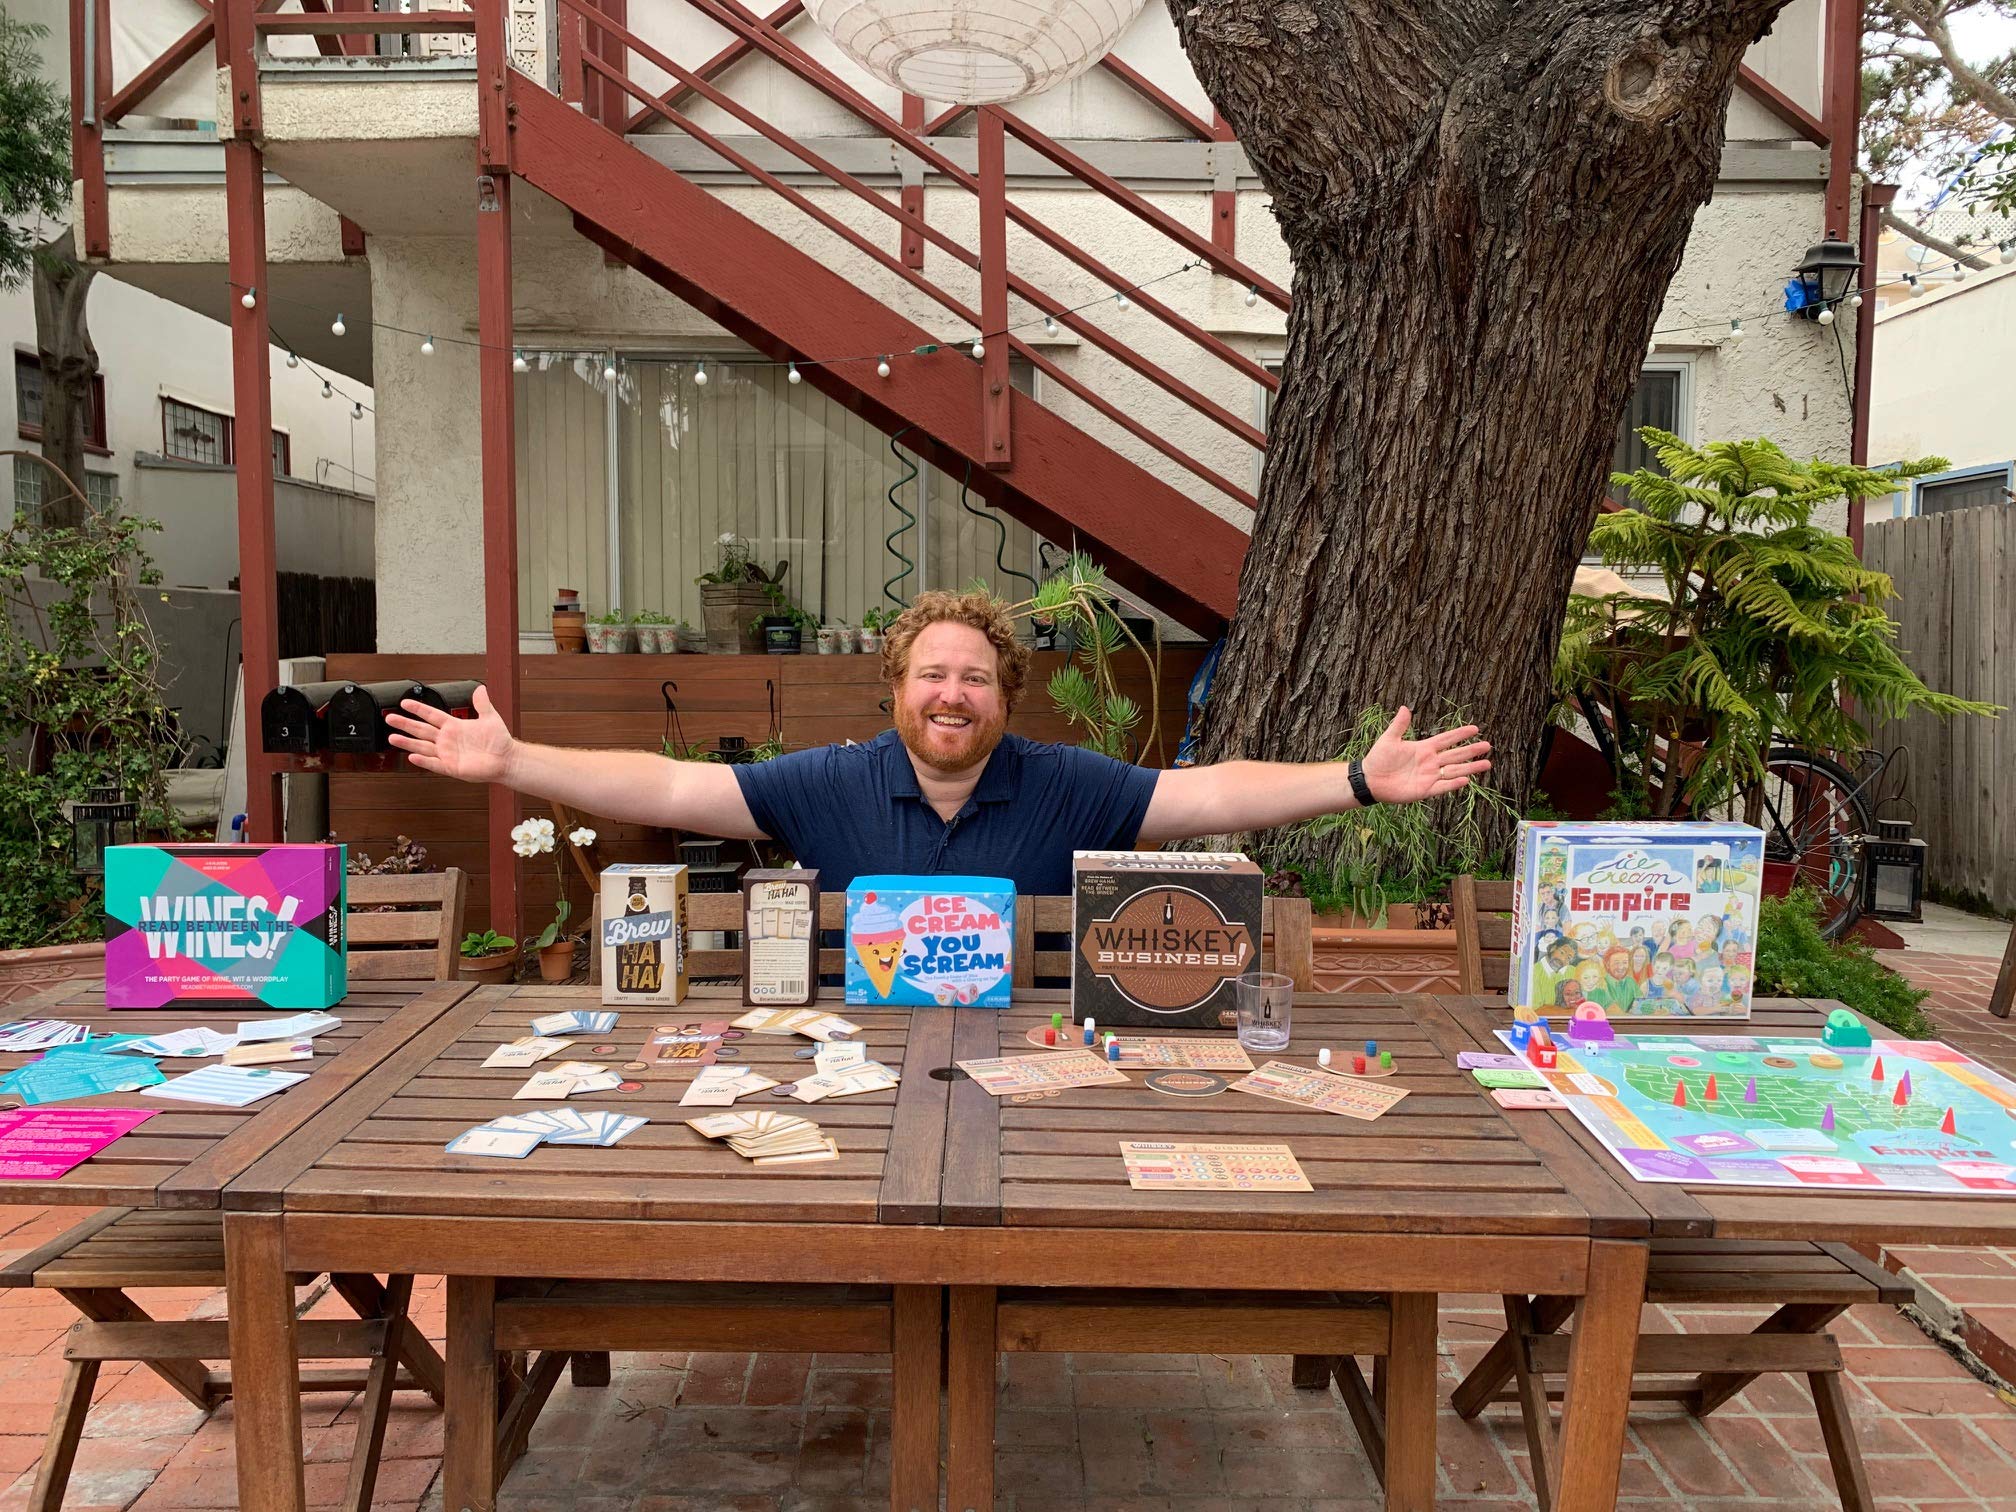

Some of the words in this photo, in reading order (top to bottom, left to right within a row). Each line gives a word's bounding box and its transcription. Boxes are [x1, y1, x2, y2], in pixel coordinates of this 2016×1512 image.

[281, 727, 289, 737] 3
[348, 725, 357, 735] 2
[1111, 862, 1225, 870] WHISKEY
[1596, 853, 1660, 870] ice
[1588, 871, 1683, 885] cream
[767, 890, 780, 900] HA
[781, 885, 798, 898] HA!
[1571, 885, 1691, 921] Empire
[922, 896, 967, 915] ICE
[138, 921, 180, 932] READ
[186, 921, 260, 932] BETWEEN
[266, 921, 295, 932] THE
[139, 895, 299, 960] WINES!
[907, 913, 1000, 935] CREAM
[1512, 879, 1523, 955] Empire
[604, 918, 672, 946] Brew
[1095, 927, 1243, 953] WHISKEY
[622, 941, 656, 964] HA
[921, 933, 981, 956] YOU
[1098, 943, 1247, 967] BUSINESS!
[621, 962, 665, 989] HA!
[903, 953, 1005, 977] SCREAM
[653, 1035, 720, 1044] Brew
[1869, 1142, 1998, 1160] Empire
